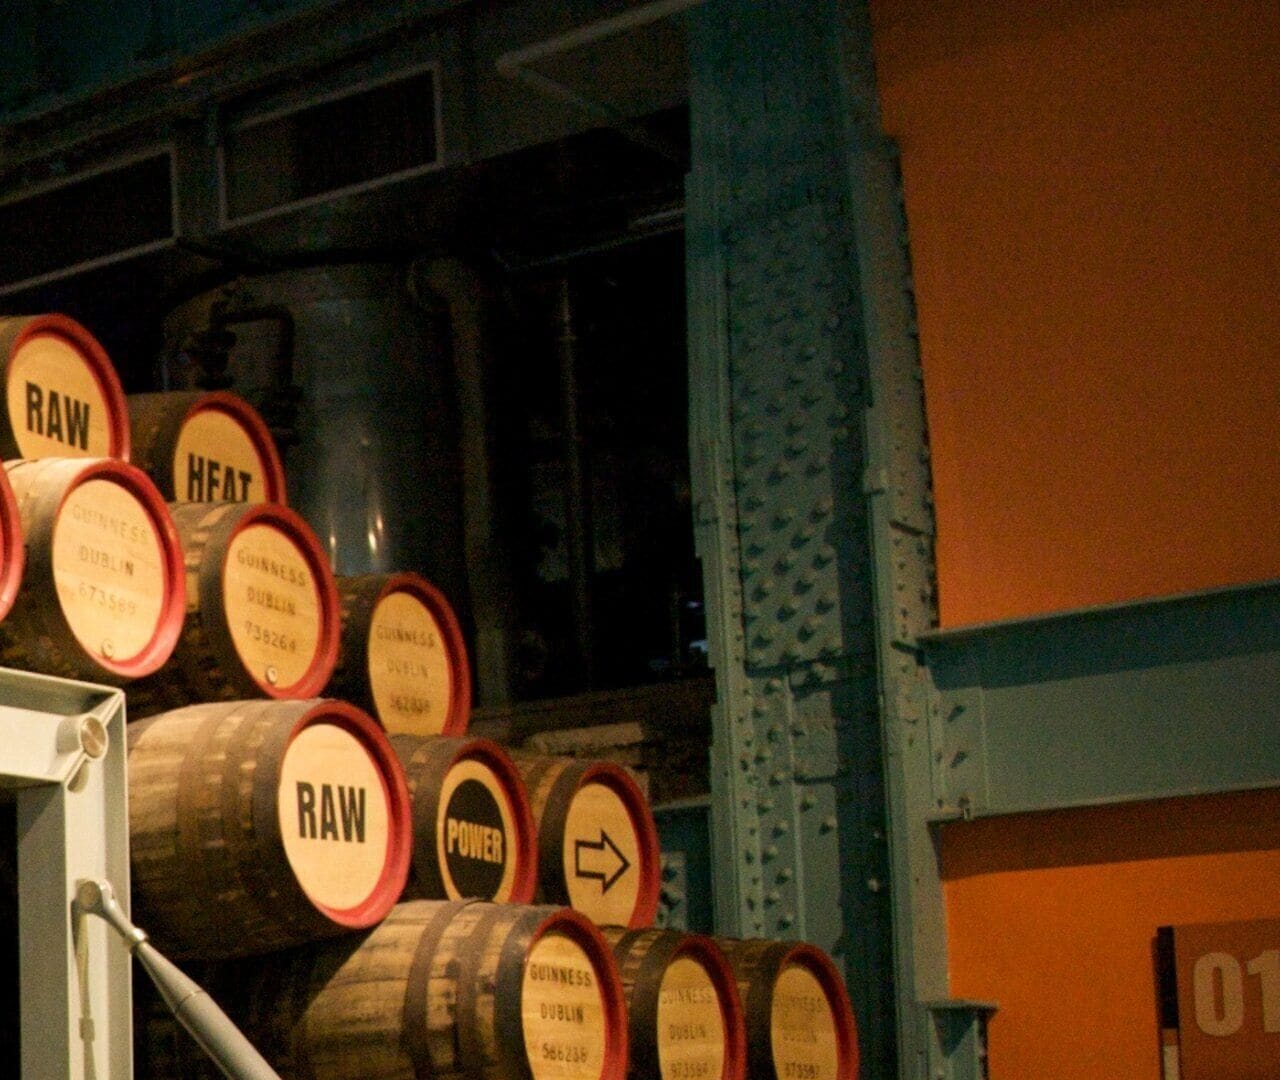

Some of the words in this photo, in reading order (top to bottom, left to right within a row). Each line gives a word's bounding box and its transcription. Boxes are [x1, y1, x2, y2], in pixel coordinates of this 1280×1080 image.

[25, 380, 91, 451] RAW
[188, 453, 252, 502] HEAT
[72, 504, 148, 545] GUINNESS
[79, 545, 134, 576] DUBLIN
[237, 550, 306, 587] GUINNESS
[247, 586, 296, 615] DUBLIN
[296, 780, 366, 843] RAW
[447, 817, 503, 864] POWER
[530, 964, 591, 987] GUINNESS
[540, 1002, 584, 1024] DUBLIN
